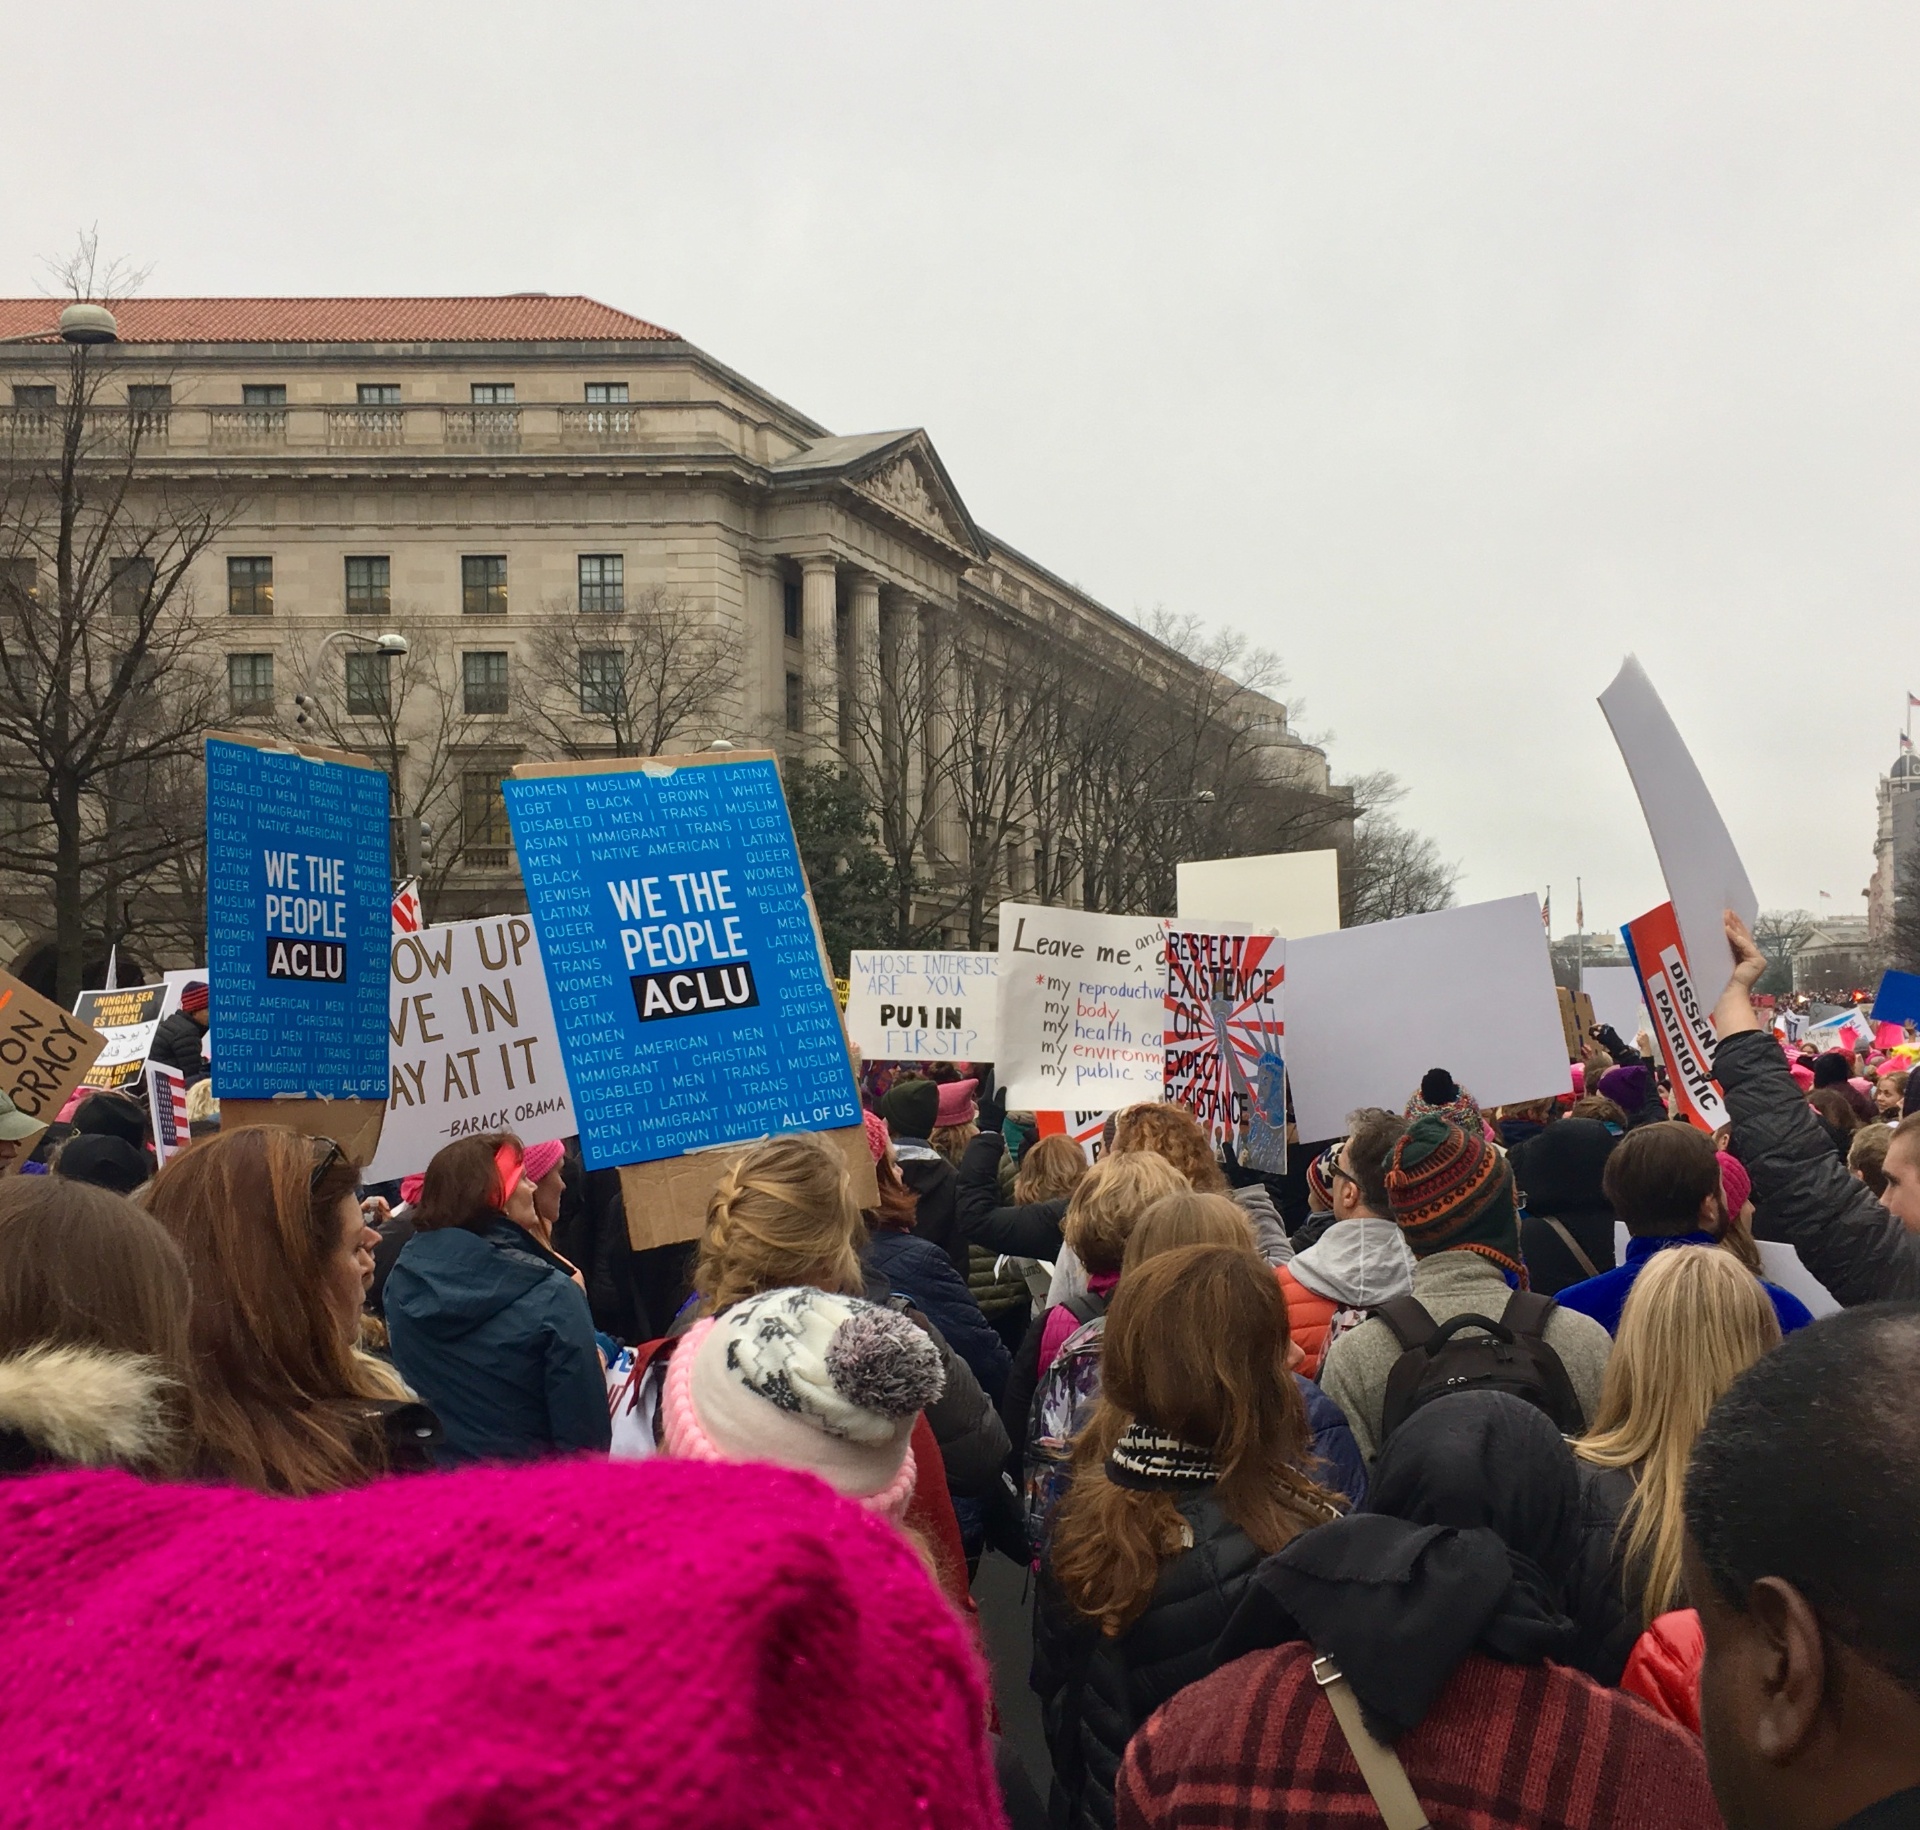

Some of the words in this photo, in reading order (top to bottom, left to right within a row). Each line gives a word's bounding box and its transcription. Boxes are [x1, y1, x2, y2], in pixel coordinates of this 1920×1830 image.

[212, 745, 250, 762] WOMEN
[263, 756, 300, 772] MUSLIM
[312, 765, 342, 780] QUEER
[354, 774, 383, 787] LATINX
[213, 764, 238, 775] LGBT
[261, 771, 292, 786] BLACK
[309, 781, 343, 796] BROWN
[511, 783, 567, 798] WOMEN
[586, 778, 642, 793] MUSLIM
[659, 772, 705, 787] QUEER
[724, 767, 770, 782] LATINX
[213, 779, 263, 797] DISABLED
[276, 790, 297, 802] MEN
[309, 796, 339, 810] TRANS
[516, 802, 552, 816] LGBT
[586, 796, 633, 810] BLACK
[658, 788, 709, 804] BROWN
[731, 783, 774, 797] WHITE
[520, 815, 593, 833] DISABLED
[612, 811, 643, 824] MEN
[662, 805, 708, 820] TRANS
[725, 800, 779, 814] MUSLIM
[525, 836, 568, 850] ASIAN
[588, 826, 667, 844] IMMIGRANT
[686, 820, 732, 833] TRANS
[749, 815, 782, 829] LGBT
[213, 845, 252, 859] JEWISH
[214, 829, 248, 842] BLACK
[528, 854, 562, 867] MEN
[591, 846, 641, 861] NATIVE
[648, 839, 720, 855] AMERICAN
[742, 832, 787, 847] LATINX
[214, 862, 250, 875] LATINX
[214, 878, 249, 892] QUEER
[264, 850, 300, 890] WE
[305, 855, 346, 896] THE
[532, 870, 581, 886] BLACK
[746, 849, 790, 864] QUEER
[537, 887, 591, 904] JEWISH
[743, 866, 794, 880] WOMEN
[214, 895, 256, 908] MUSLIM
[540, 904, 592, 921] LATINX
[746, 883, 798, 897] MUSLIM
[607, 877, 667, 921] WE
[668, 869, 736, 914] THE
[215, 912, 249, 925] TRANS
[266, 894, 347, 938] PEOPLE
[545, 922, 595, 939] QUEER
[760, 900, 803, 914] BLACK
[214, 928, 254, 941] WOMEN
[215, 945, 242, 957] LGBT
[391, 929, 452, 984] OW
[475, 920, 530, 970] UP
[549, 939, 607, 956] MUSLIM
[777, 917, 806, 929] MEN
[620, 916, 748, 971] PEOPLE
[1013, 918, 1084, 958] Leave
[1096, 946, 1131, 965] me
[1169, 932, 1245, 966] RESPECT
[215, 962, 251, 973] LATINX
[271, 942, 342, 979] ACLU
[552, 958, 602, 974] TRANS
[766, 933, 811, 948] LATINX
[556, 975, 613, 992] WOMEN
[777, 950, 815, 964] ASIAN
[855, 955, 917, 974] WHOSE
[137, 991, 154, 1001] SER
[215, 979, 256, 990] WOMEN
[561, 995, 597, 1011] LGBT
[790, 967, 819, 981] MEN
[644, 966, 751, 1017] ACLU
[867, 975, 902, 995] ARE
[926, 976, 966, 996] YOU
[1168, 963, 1274, 1004] EXISTENCE
[93, 1017, 106, 1026] ES
[101, 1004, 141, 1016] HUMANO
[390, 993, 444, 1047] VE
[462, 978, 518, 1034] IN
[564, 1012, 616, 1030] LATINX
[779, 983, 823, 1000] QUEER
[567, 1029, 625, 1047] WOMEN
[780, 1002, 828, 1018] JEWISH
[1045, 1001, 1069, 1023] my
[1077, 998, 1119, 1024] body
[1174, 1002, 1203, 1041] OR
[1670, 961, 1718, 1060] DISSEN
[572, 1047, 624, 1066] NATIVE
[634, 1035, 708, 1056] AMERICAN
[733, 1027, 764, 1041] MEN
[787, 1018, 833, 1034] LATINX
[887, 1030, 977, 1056] FIRST?
[1043, 1020, 1068, 1044] my
[1075, 1019, 1131, 1043] health
[1141, 1033, 1162, 1048] ca
[1656, 989, 1718, 1110] PATRIOTIC
[9, 1014, 88, 1116] CRACY
[87, 1067, 113, 1075] MAN
[115, 1061, 141, 1074] BEING
[576, 1061, 659, 1084] IMMIGRANT
[692, 1046, 767, 1066] CHRISTIAN
[798, 1035, 836, 1050] ASIAN
[1042, 1041, 1067, 1065] my
[1073, 1044, 1164, 1064] environm
[1165, 1050, 1219, 1081] EXPECT
[342, 1080, 358, 1091] ALL
[361, 1080, 372, 1091] OF
[374, 1080, 386, 1091] US
[390, 1060, 426, 1110] AY
[444, 1048, 480, 1102] AT
[499, 1036, 538, 1090] IT
[581, 1081, 653, 1103] DISABLED
[673, 1074, 704, 1088] MEN
[724, 1063, 770, 1080] TRANS
[788, 1052, 841, 1070] MUSLIM
[1041, 1064, 1067, 1086] my
[1076, 1062, 1133, 1086] public
[515, 1096, 566, 1121] OBAMA
[584, 1103, 634, 1122] QUEER
[660, 1091, 709, 1110] LATINX
[742, 1079, 788, 1095] TRANS
[811, 1069, 844, 1085] LGBT
[588, 1124, 621, 1140] MEN
[638, 1107, 718, 1132] IMMIGRANT
[734, 1099, 788, 1115] WOMEN
[804, 1087, 850, 1104] LATINX
[592, 1139, 644, 1159] BLACK
[656, 1129, 709, 1148] BROWN
[724, 1119, 769, 1137] WHITE
[782, 1112, 810, 1128] ALL
[813, 1107, 831, 1121] OF
[835, 1104, 854, 1118] US
